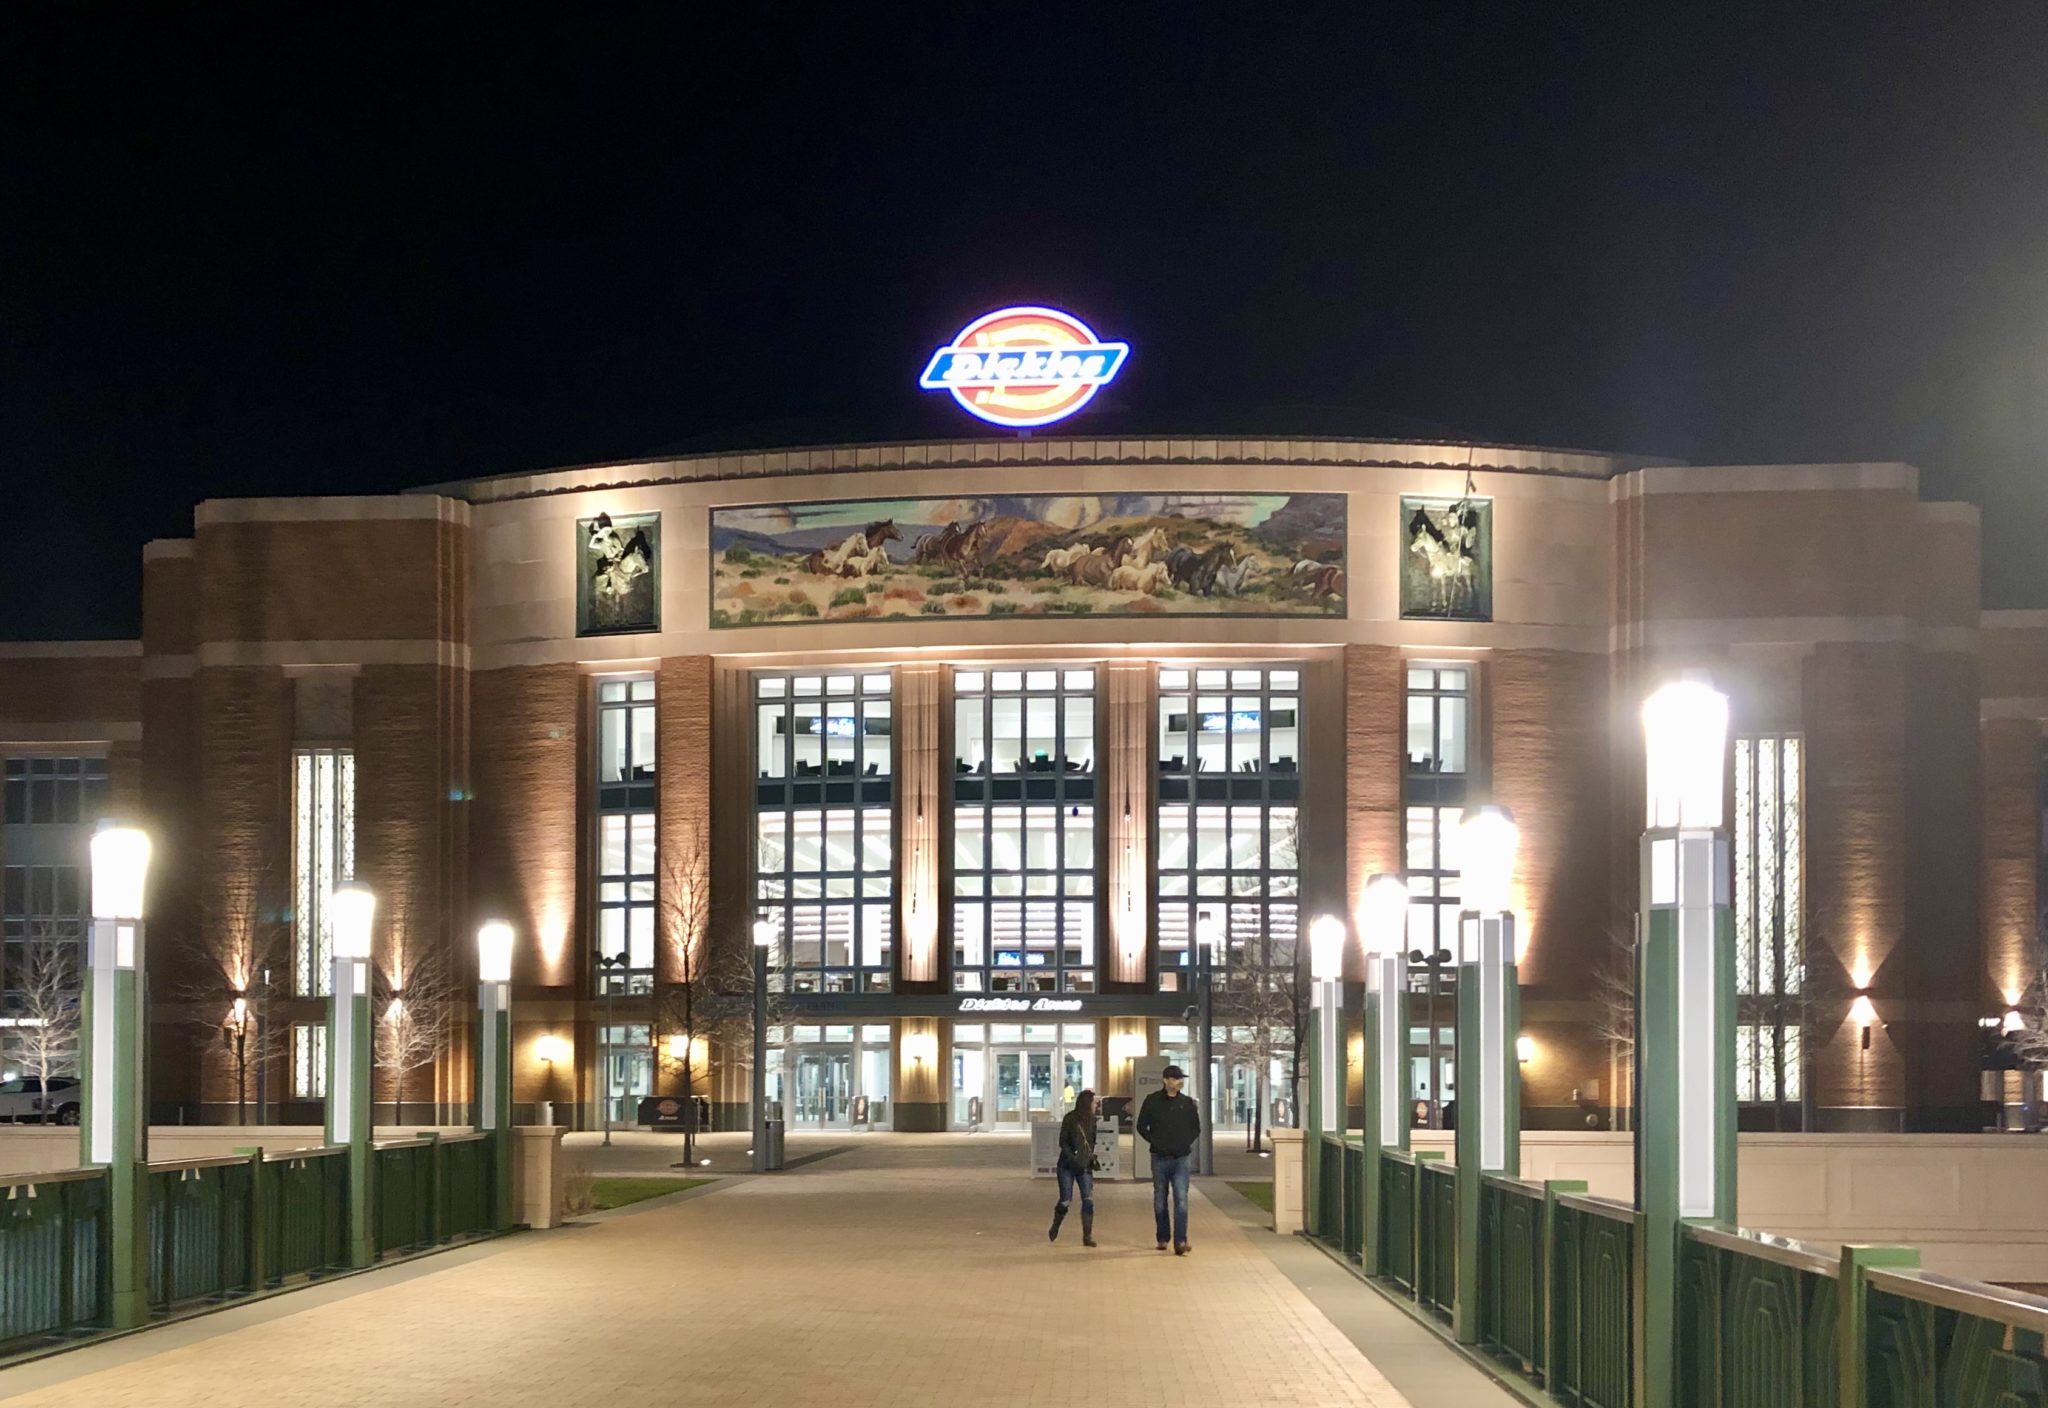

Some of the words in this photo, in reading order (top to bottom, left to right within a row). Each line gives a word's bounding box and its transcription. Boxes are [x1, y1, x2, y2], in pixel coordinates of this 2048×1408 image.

[942, 350, 1106, 381] Dickies
[959, 998, 1030, 1011] Dickies
[1032, 998, 1082, 1011] Arena
